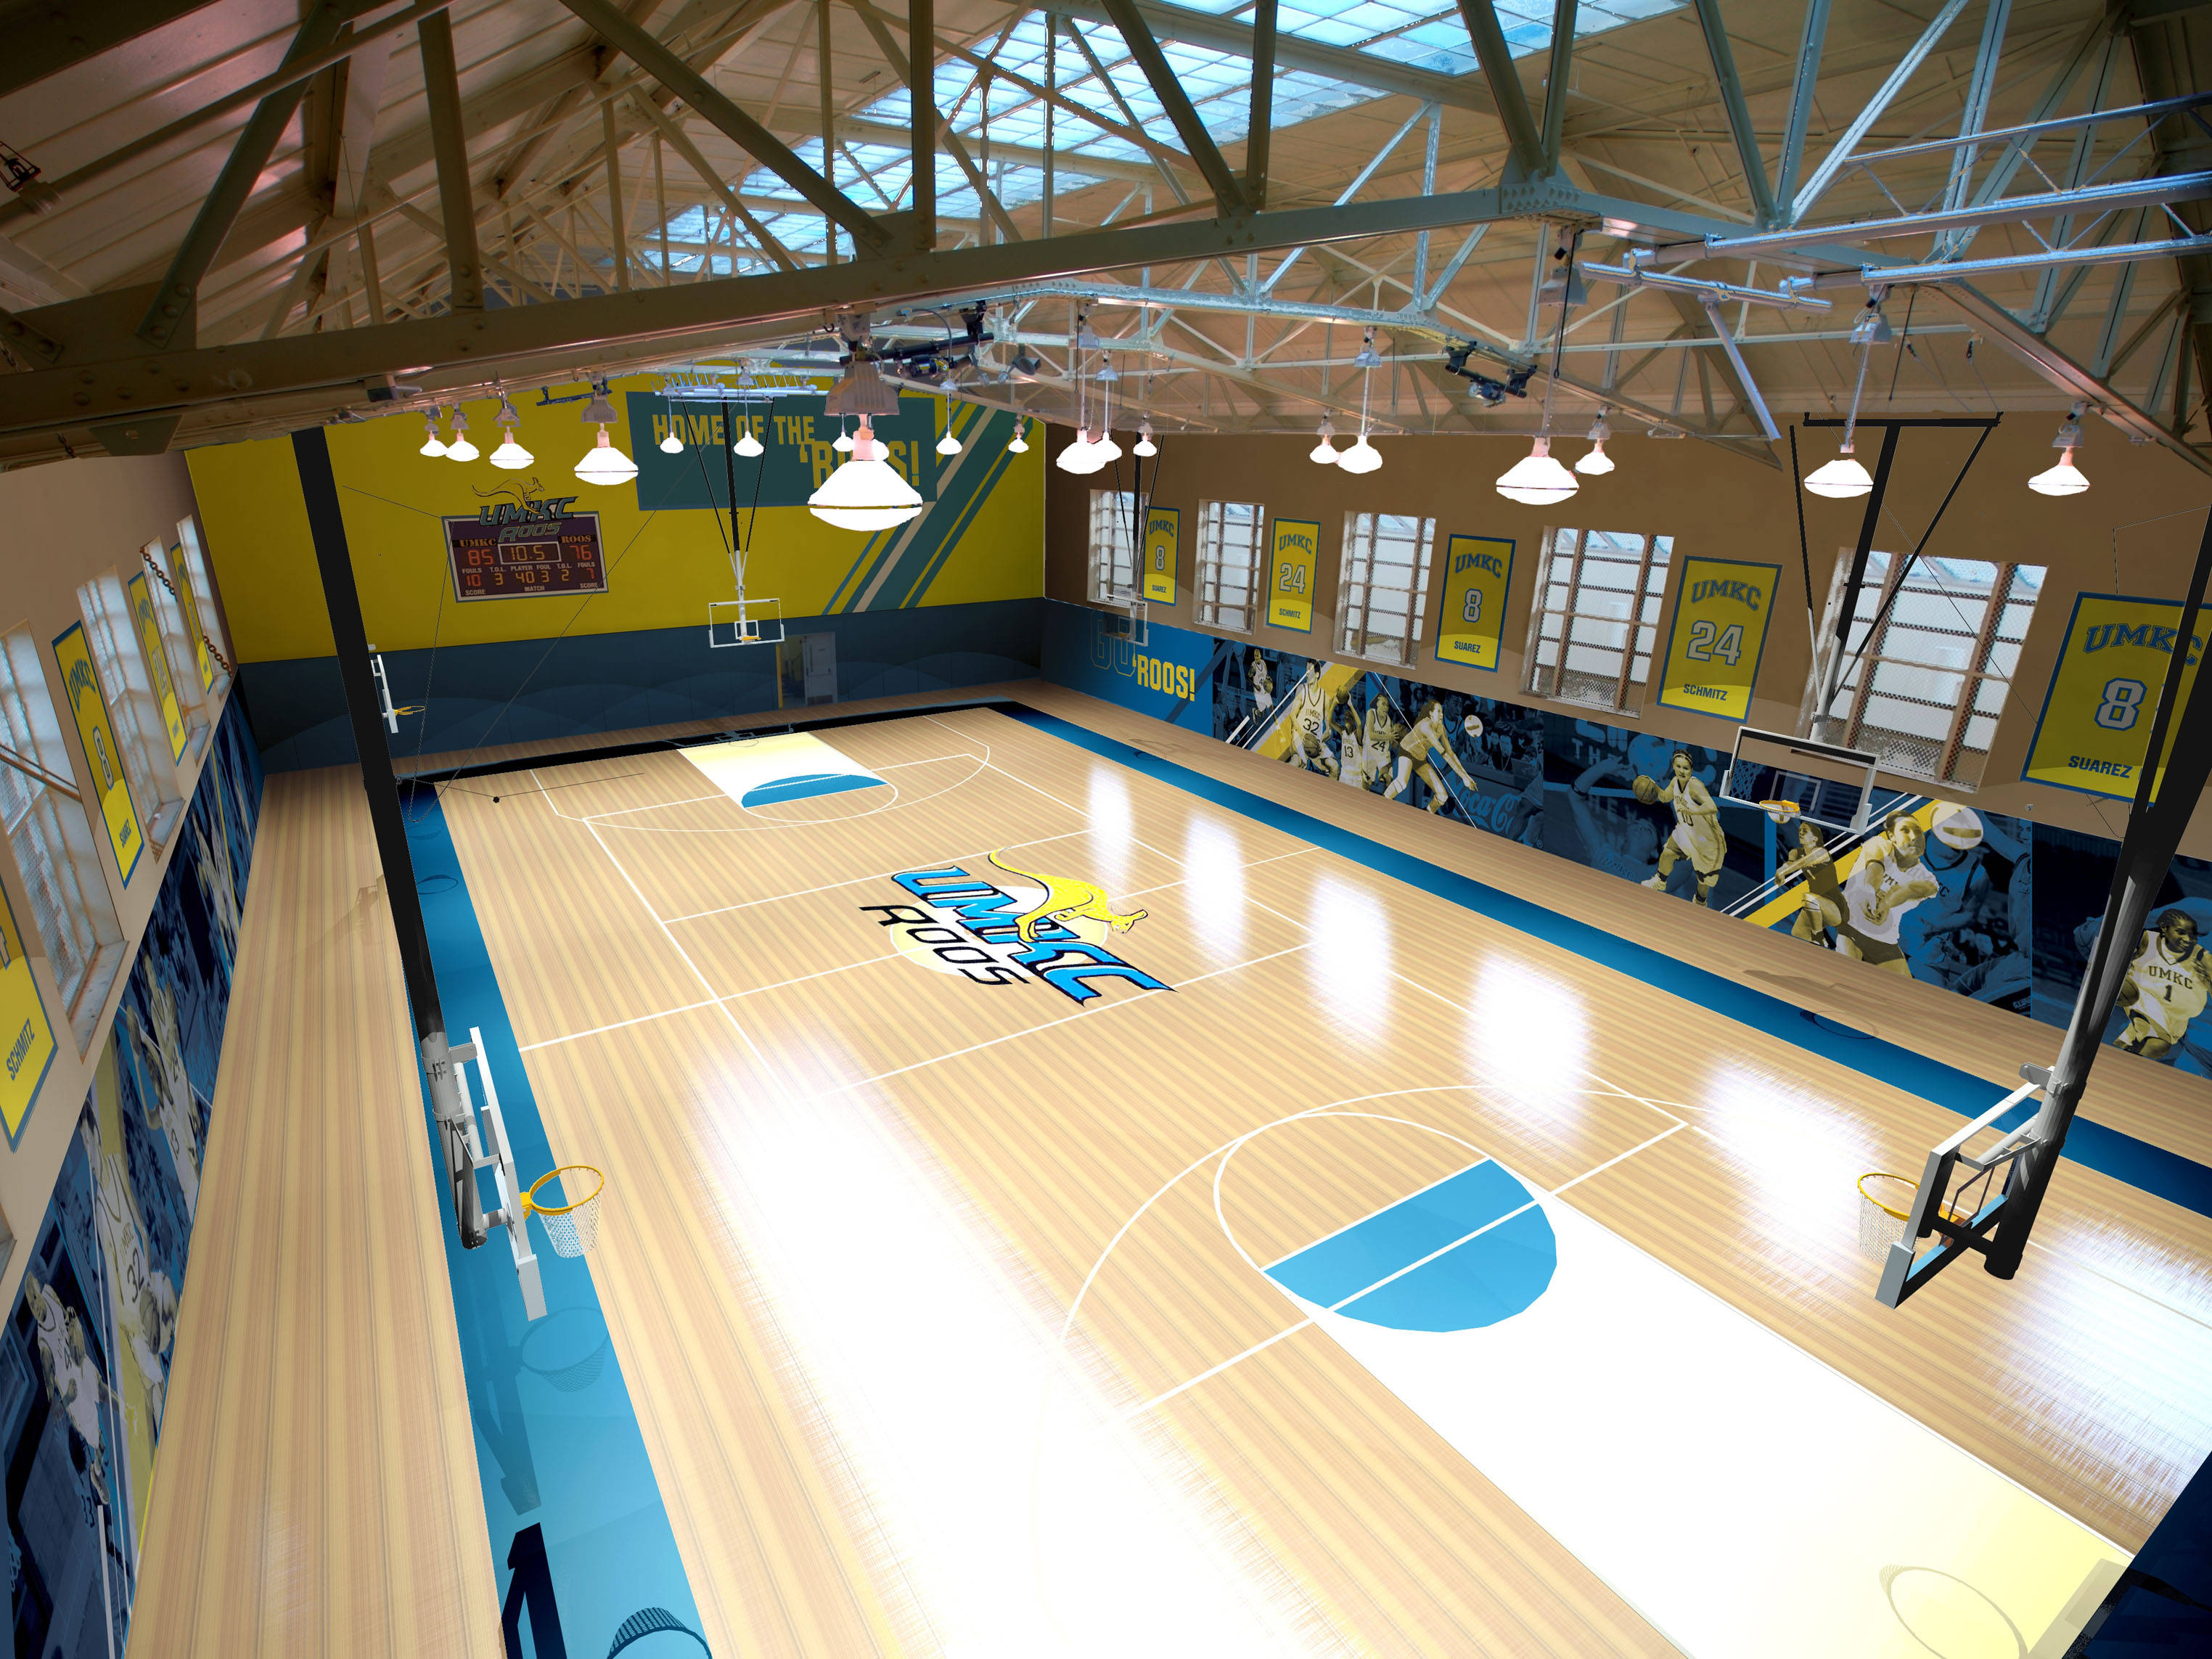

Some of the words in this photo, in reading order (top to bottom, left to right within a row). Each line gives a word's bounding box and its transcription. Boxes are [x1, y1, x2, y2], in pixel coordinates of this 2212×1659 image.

[652, 414, 724, 445] HOME
[736, 415, 764, 445] OF
[774, 416, 815, 445] THE
[480, 496, 579, 526] UMKC
[459, 538, 497, 547] UMKC
[561, 535, 592, 544] ROOS
[499, 523, 562, 542] ROOS
[1150, 520, 1174, 538] UMKC
[467, 549, 494, 566] 85
[510, 546, 545, 562] 10.5
[569, 544, 592, 560] 76
[1279, 533, 1312, 555] UMKC
[1155, 545, 1166, 570] 8
[1454, 552, 1504, 579] UMKC
[466, 573, 481, 587] 10
[495, 573, 504, 586] 3
[515, 570, 535, 583] 40
[541, 570, 550, 583] 3
[561, 569, 570, 581] 2
[586, 568, 595, 579] 7
[1152, 584, 1166, 594] SUAREZ
[1279, 562, 1306, 594] 24
[1462, 588, 1483, 623] 8
[1690, 578, 1763, 612] UMKC
[1279, 608, 1301, 619] SCHMITZ
[1454, 640, 1481, 655] SUAREZ
[1686, 620, 1743, 667] 24
[68, 658, 97, 713] UMKC
[1683, 683, 1728, 702] SCHMITZ
[2094, 677, 2147, 731] 8
[1303, 718, 1319, 736] 32
[93, 726, 115, 791] 8
[1344, 745, 1353, 758] 13
[2068, 755, 2133, 779] SUAREZ
[859, 904, 1031, 986] ROOS
[891, 865, 1179, 1007] UMKC
[2148, 965, 2193, 990] UMKC
[2163, 984, 2172, 1002] 1
[5, 1017, 35, 1081] SCHMITZ
[126, 1248, 144, 1303] 32
